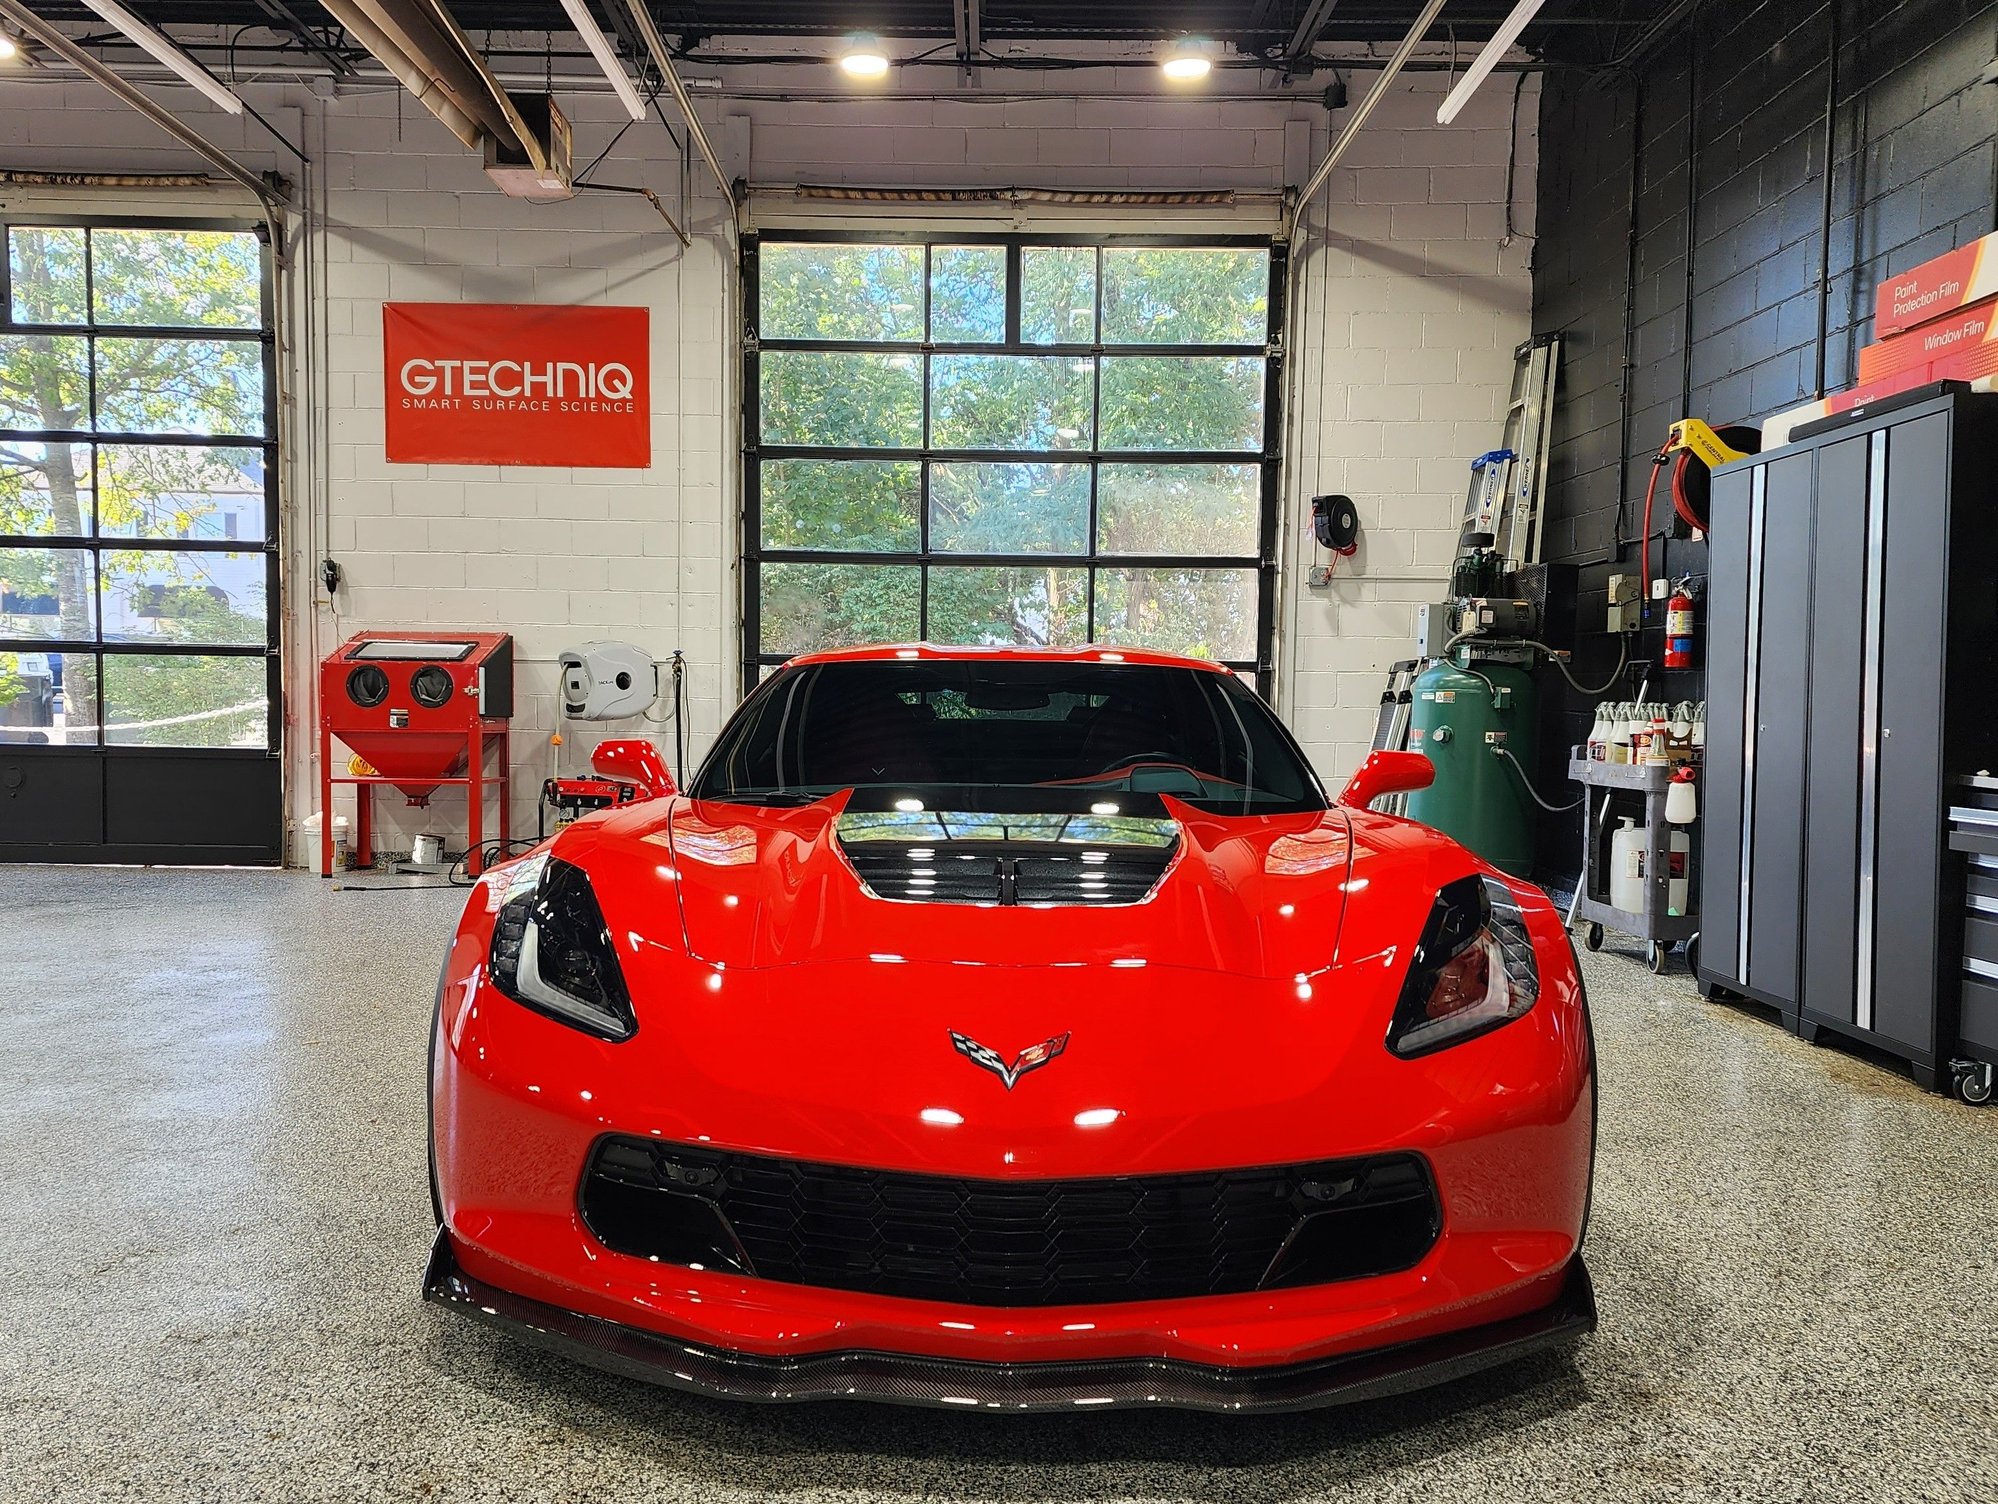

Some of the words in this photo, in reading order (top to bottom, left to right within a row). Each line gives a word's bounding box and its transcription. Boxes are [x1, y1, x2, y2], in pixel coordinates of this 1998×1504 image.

[1893, 290, 1938, 318] Protection
[1939, 281, 1960, 299] Film
[1894, 281, 1918, 301] Paint
[1924, 329, 1961, 351] Window
[1962, 320, 1985, 338] Film
[401, 358, 633, 399] GTECHNIQ
[402, 398, 461, 410] SMART
[472, 400, 550, 411] SURFACE
[560, 401, 634, 413] SCIENCE
